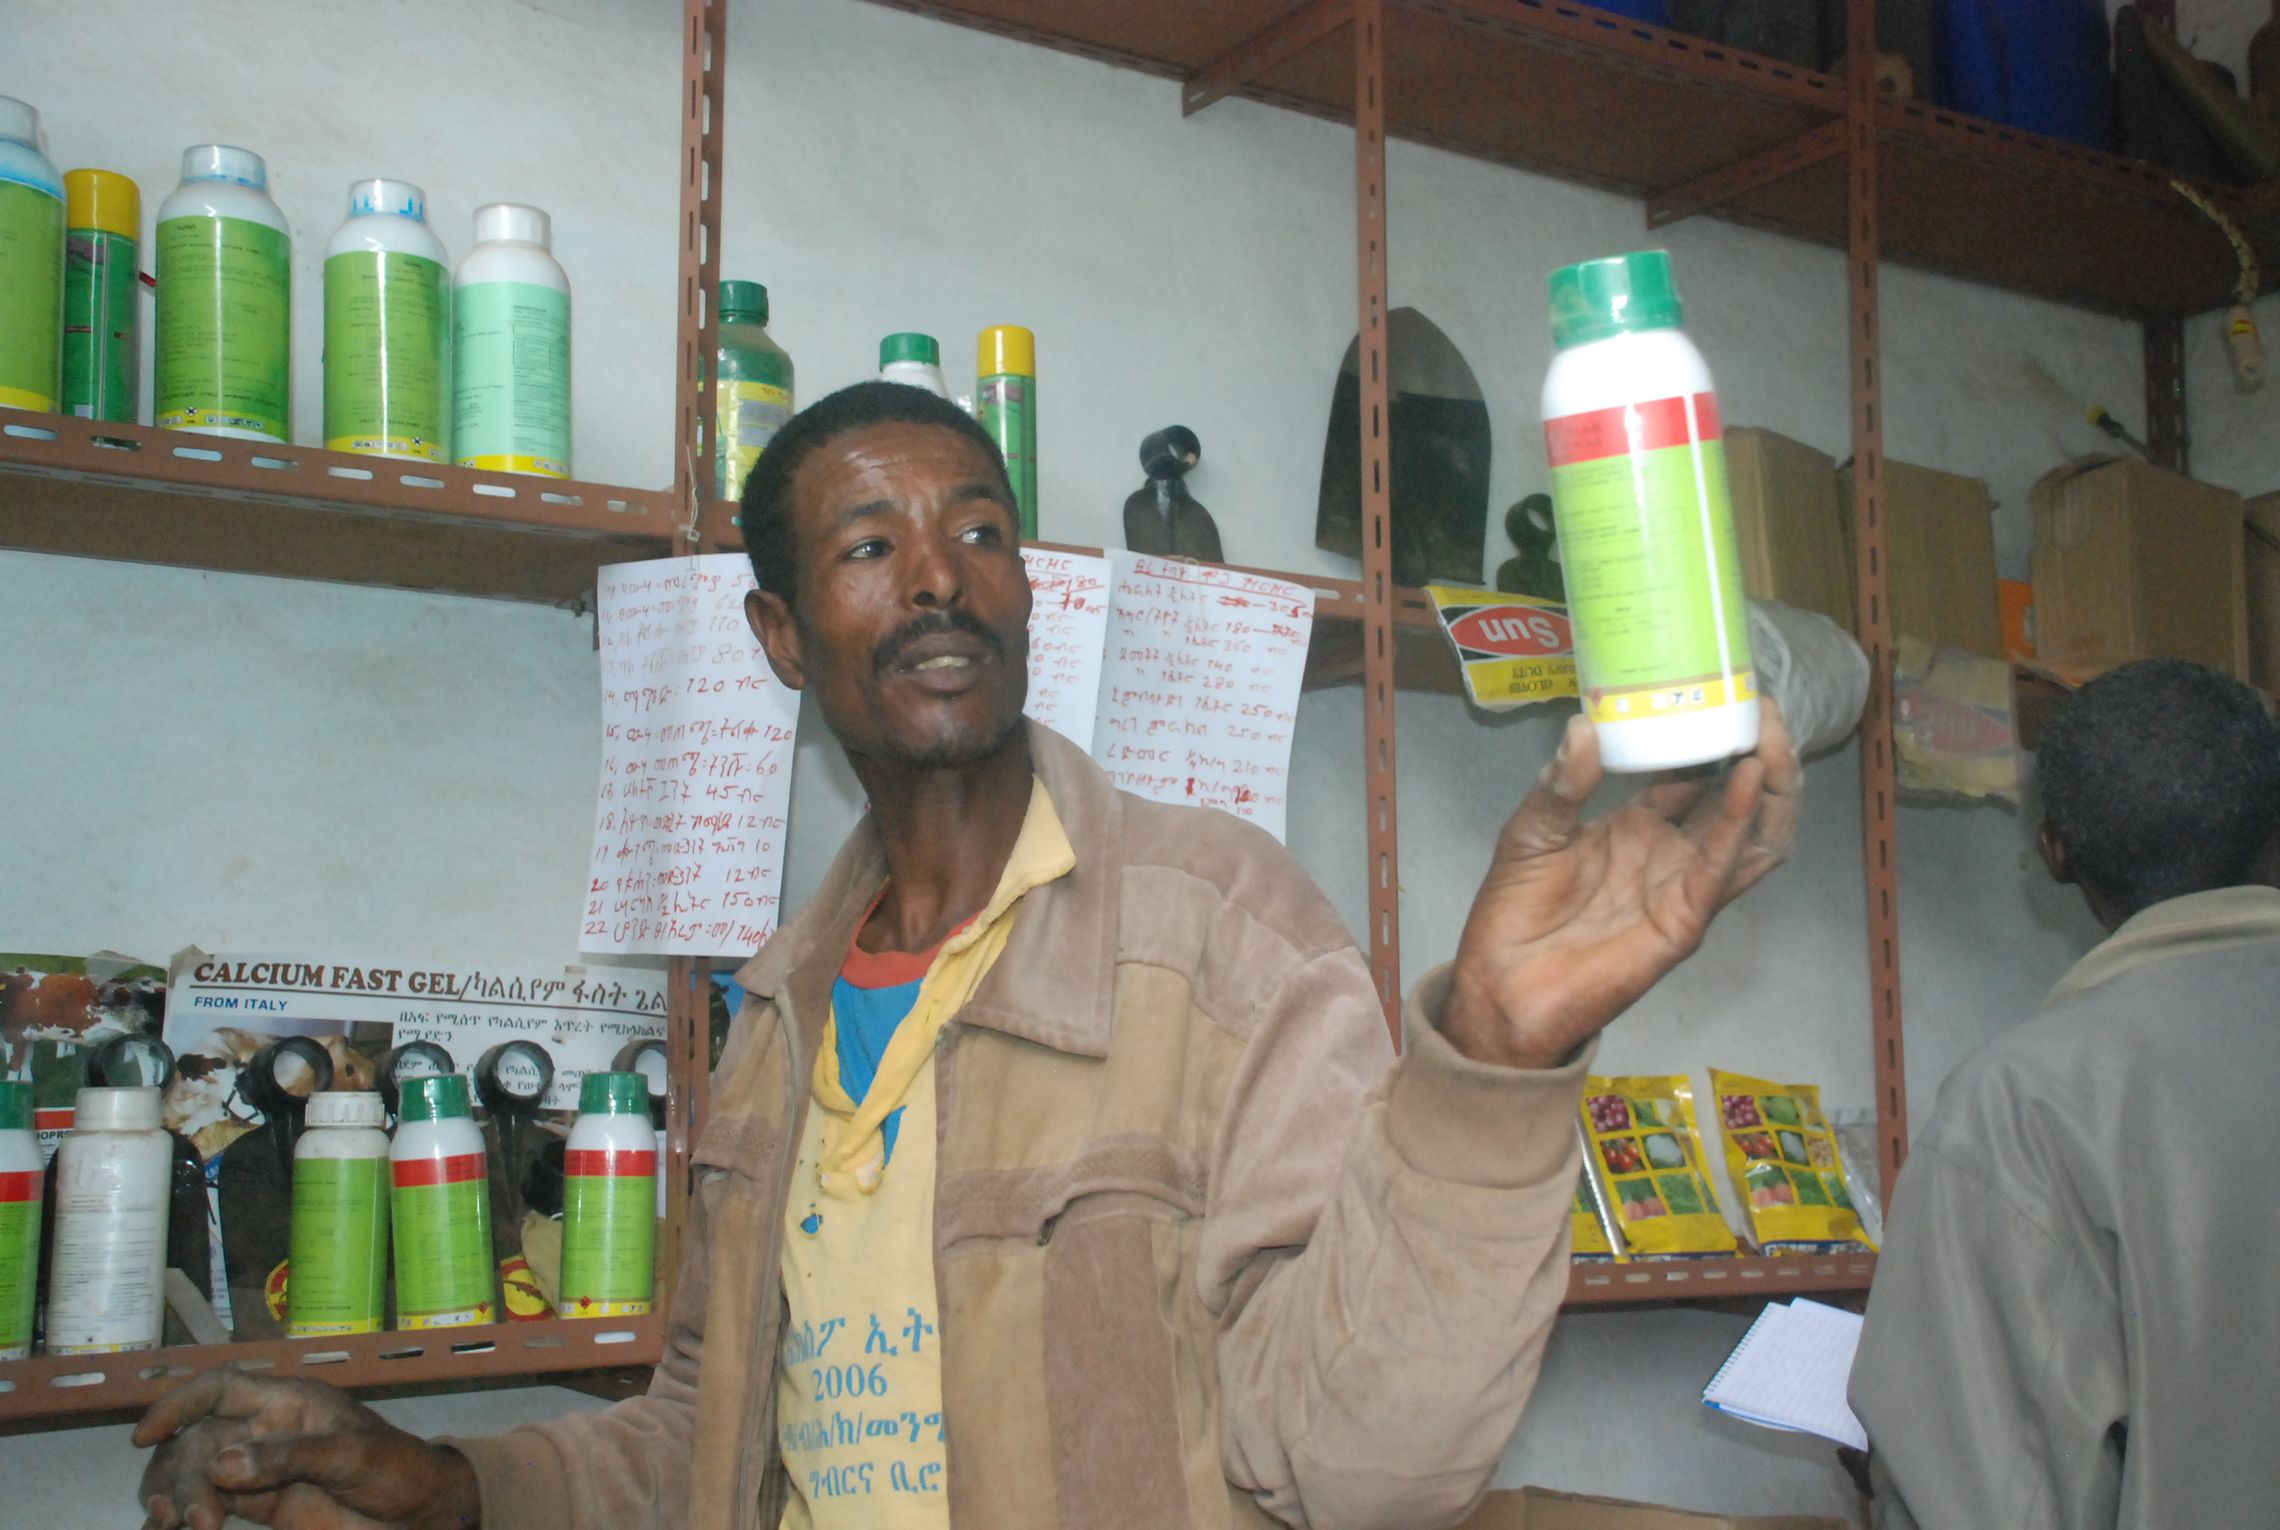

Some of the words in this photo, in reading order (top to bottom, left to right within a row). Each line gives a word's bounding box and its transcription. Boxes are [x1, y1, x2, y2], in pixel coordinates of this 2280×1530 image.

[1478, 617, 1560, 649] Sun
[194, 961, 326, 988] CALCIUM
[330, 965, 403, 993] FAST
[193, 996, 239, 1009] FROM
[243, 999, 288, 1012] ITALY
[811, 1364, 888, 1402] 2006
[890, 1460, 942, 1494] ቢሮ
